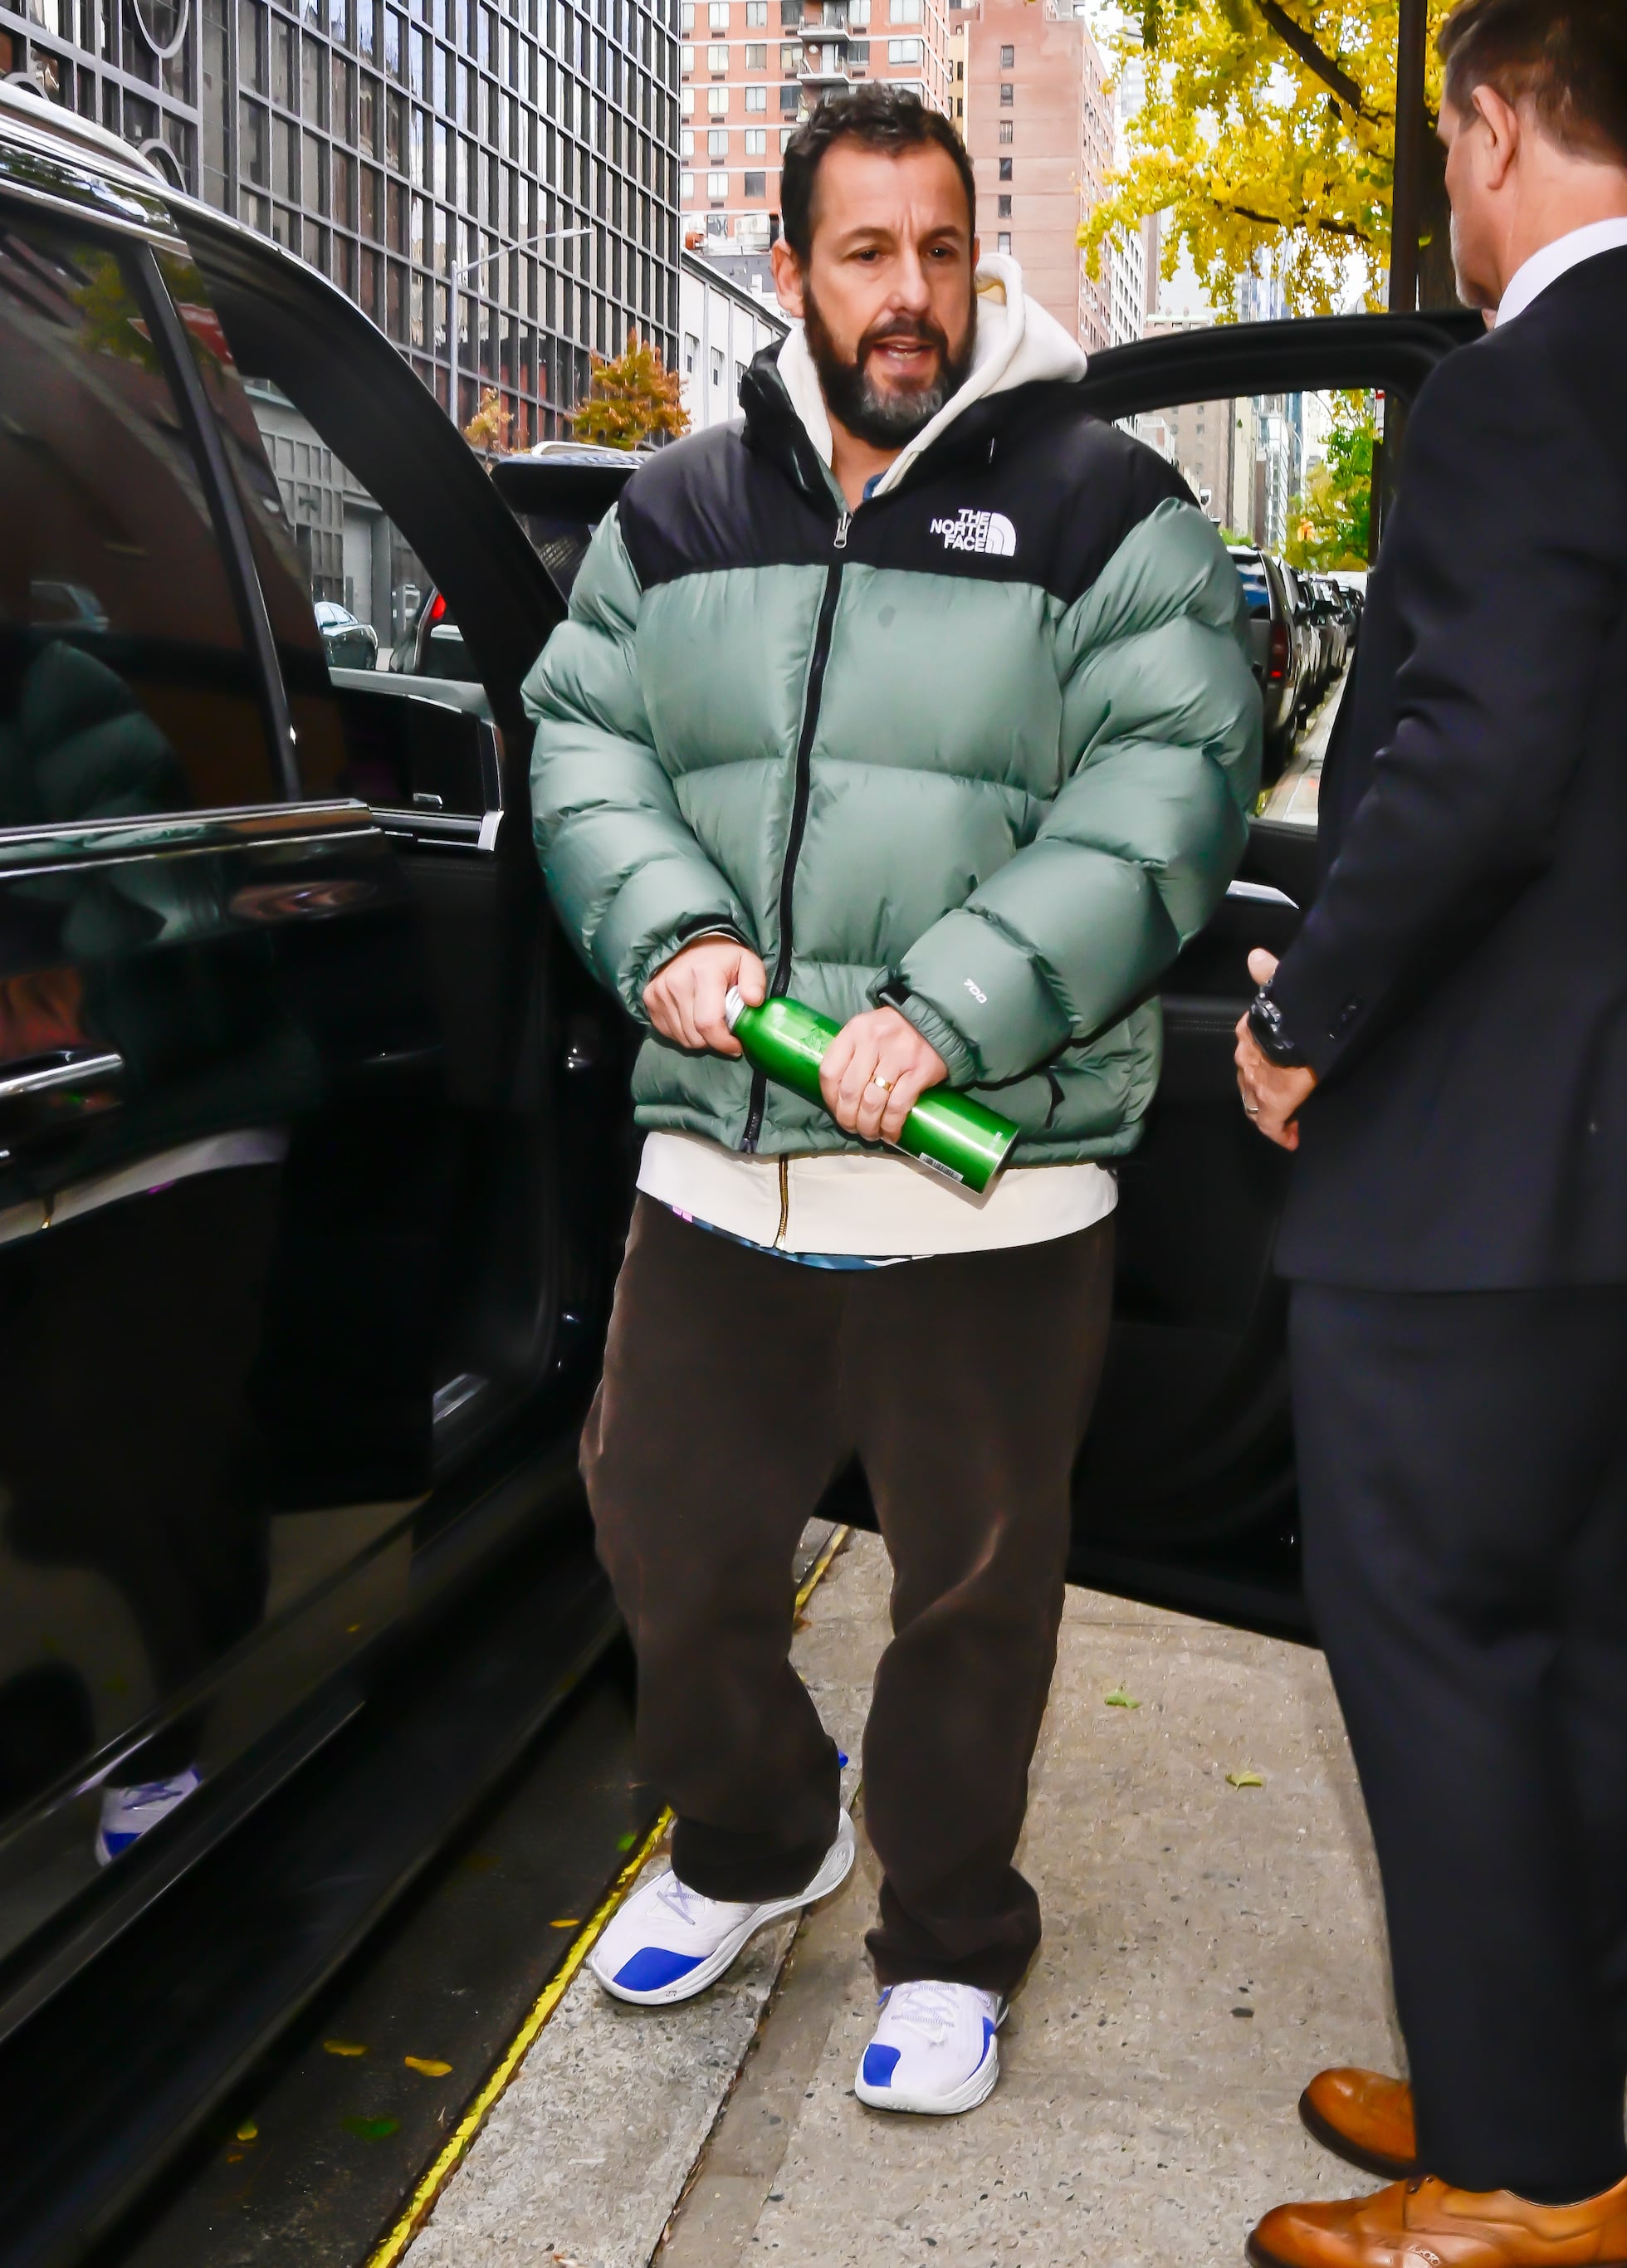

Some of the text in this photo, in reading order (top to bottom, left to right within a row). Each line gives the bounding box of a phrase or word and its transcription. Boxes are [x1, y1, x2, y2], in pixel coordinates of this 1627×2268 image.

[958, 508, 991, 525] THE
[930, 518, 989, 539] NORTH
[944, 534, 985, 553] FACE
